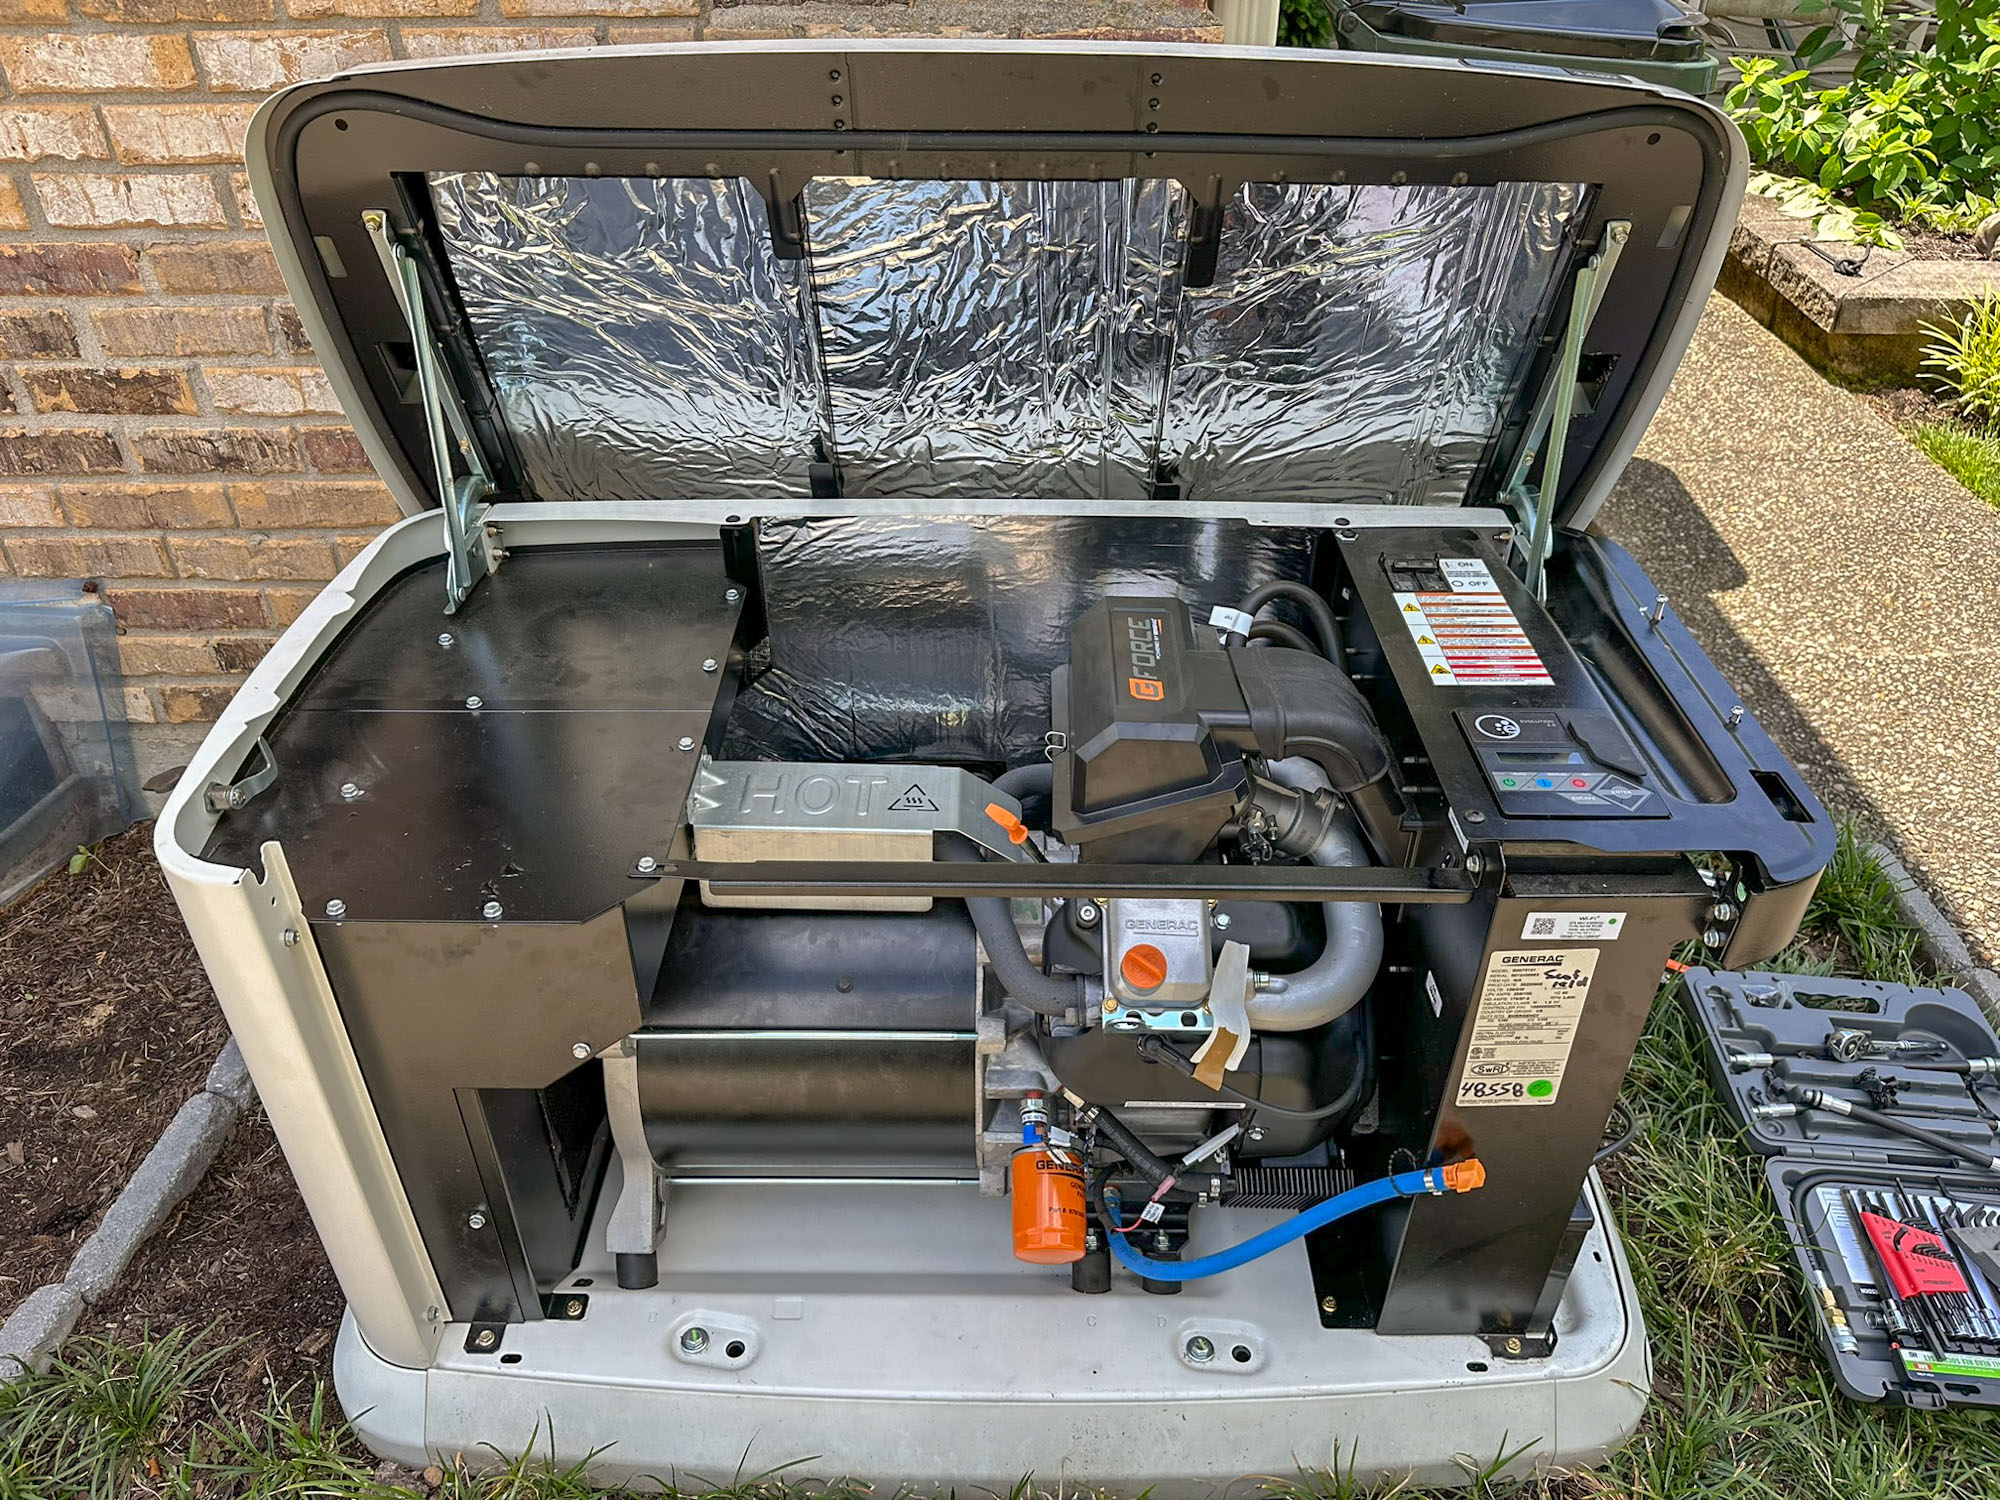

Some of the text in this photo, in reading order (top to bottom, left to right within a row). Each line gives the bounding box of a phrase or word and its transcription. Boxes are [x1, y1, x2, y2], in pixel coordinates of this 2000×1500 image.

[1127, 616, 1158, 680] FORCE
[739, 773, 890, 816] HOT
[1124, 919, 1199, 931] GENERAC
[1502, 955, 1564, 963] GENERAC
[1460, 1082, 1525, 1098] 48558
[1086, 1315, 1097, 1327] C
[1157, 1315, 1167, 1328] D
